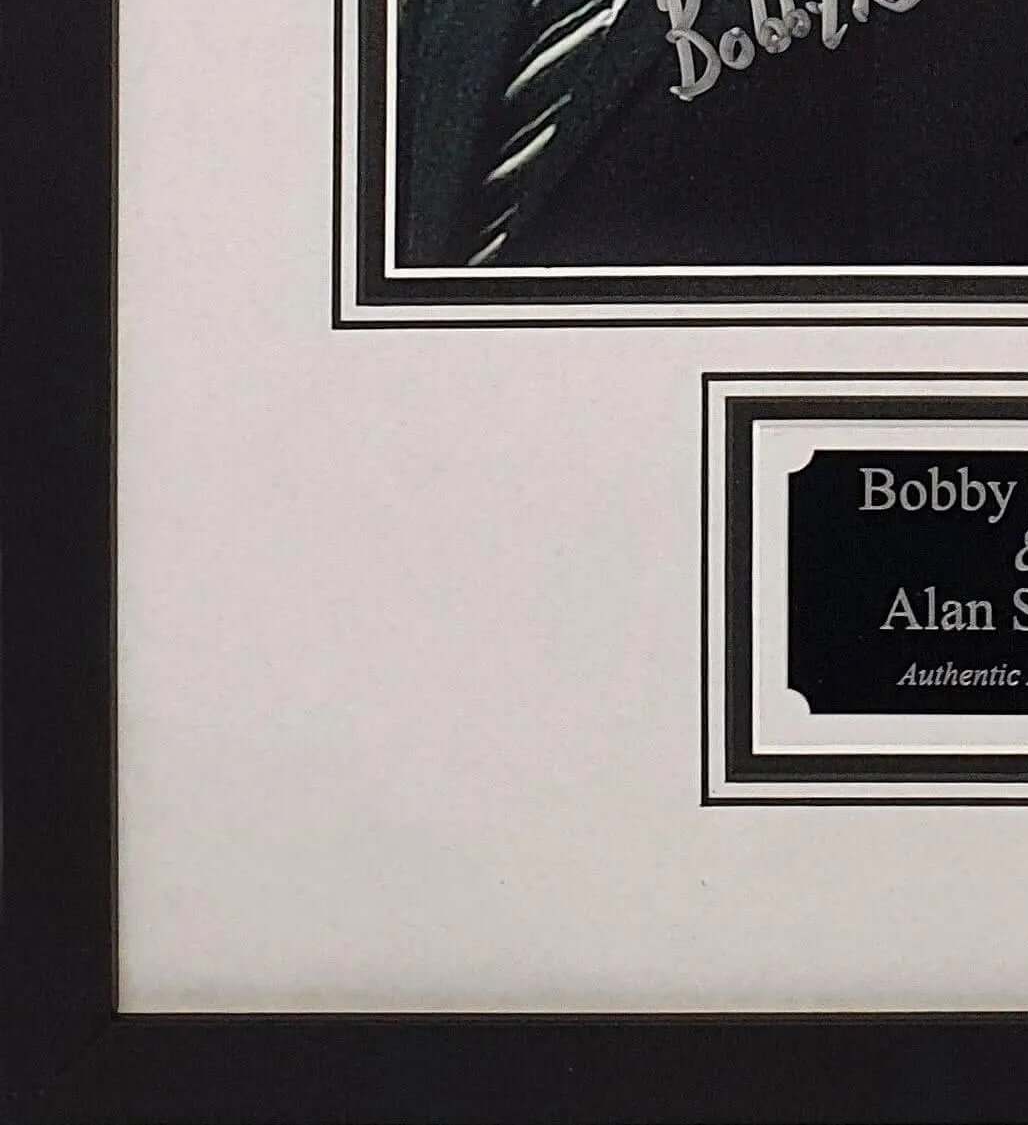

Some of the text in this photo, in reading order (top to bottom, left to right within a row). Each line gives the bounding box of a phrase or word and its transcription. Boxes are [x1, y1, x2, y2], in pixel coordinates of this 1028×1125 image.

[859, 467, 1017, 523] Bobby
[880, 587, 996, 631] Alan
[897, 662, 1021, 687] Authentic
